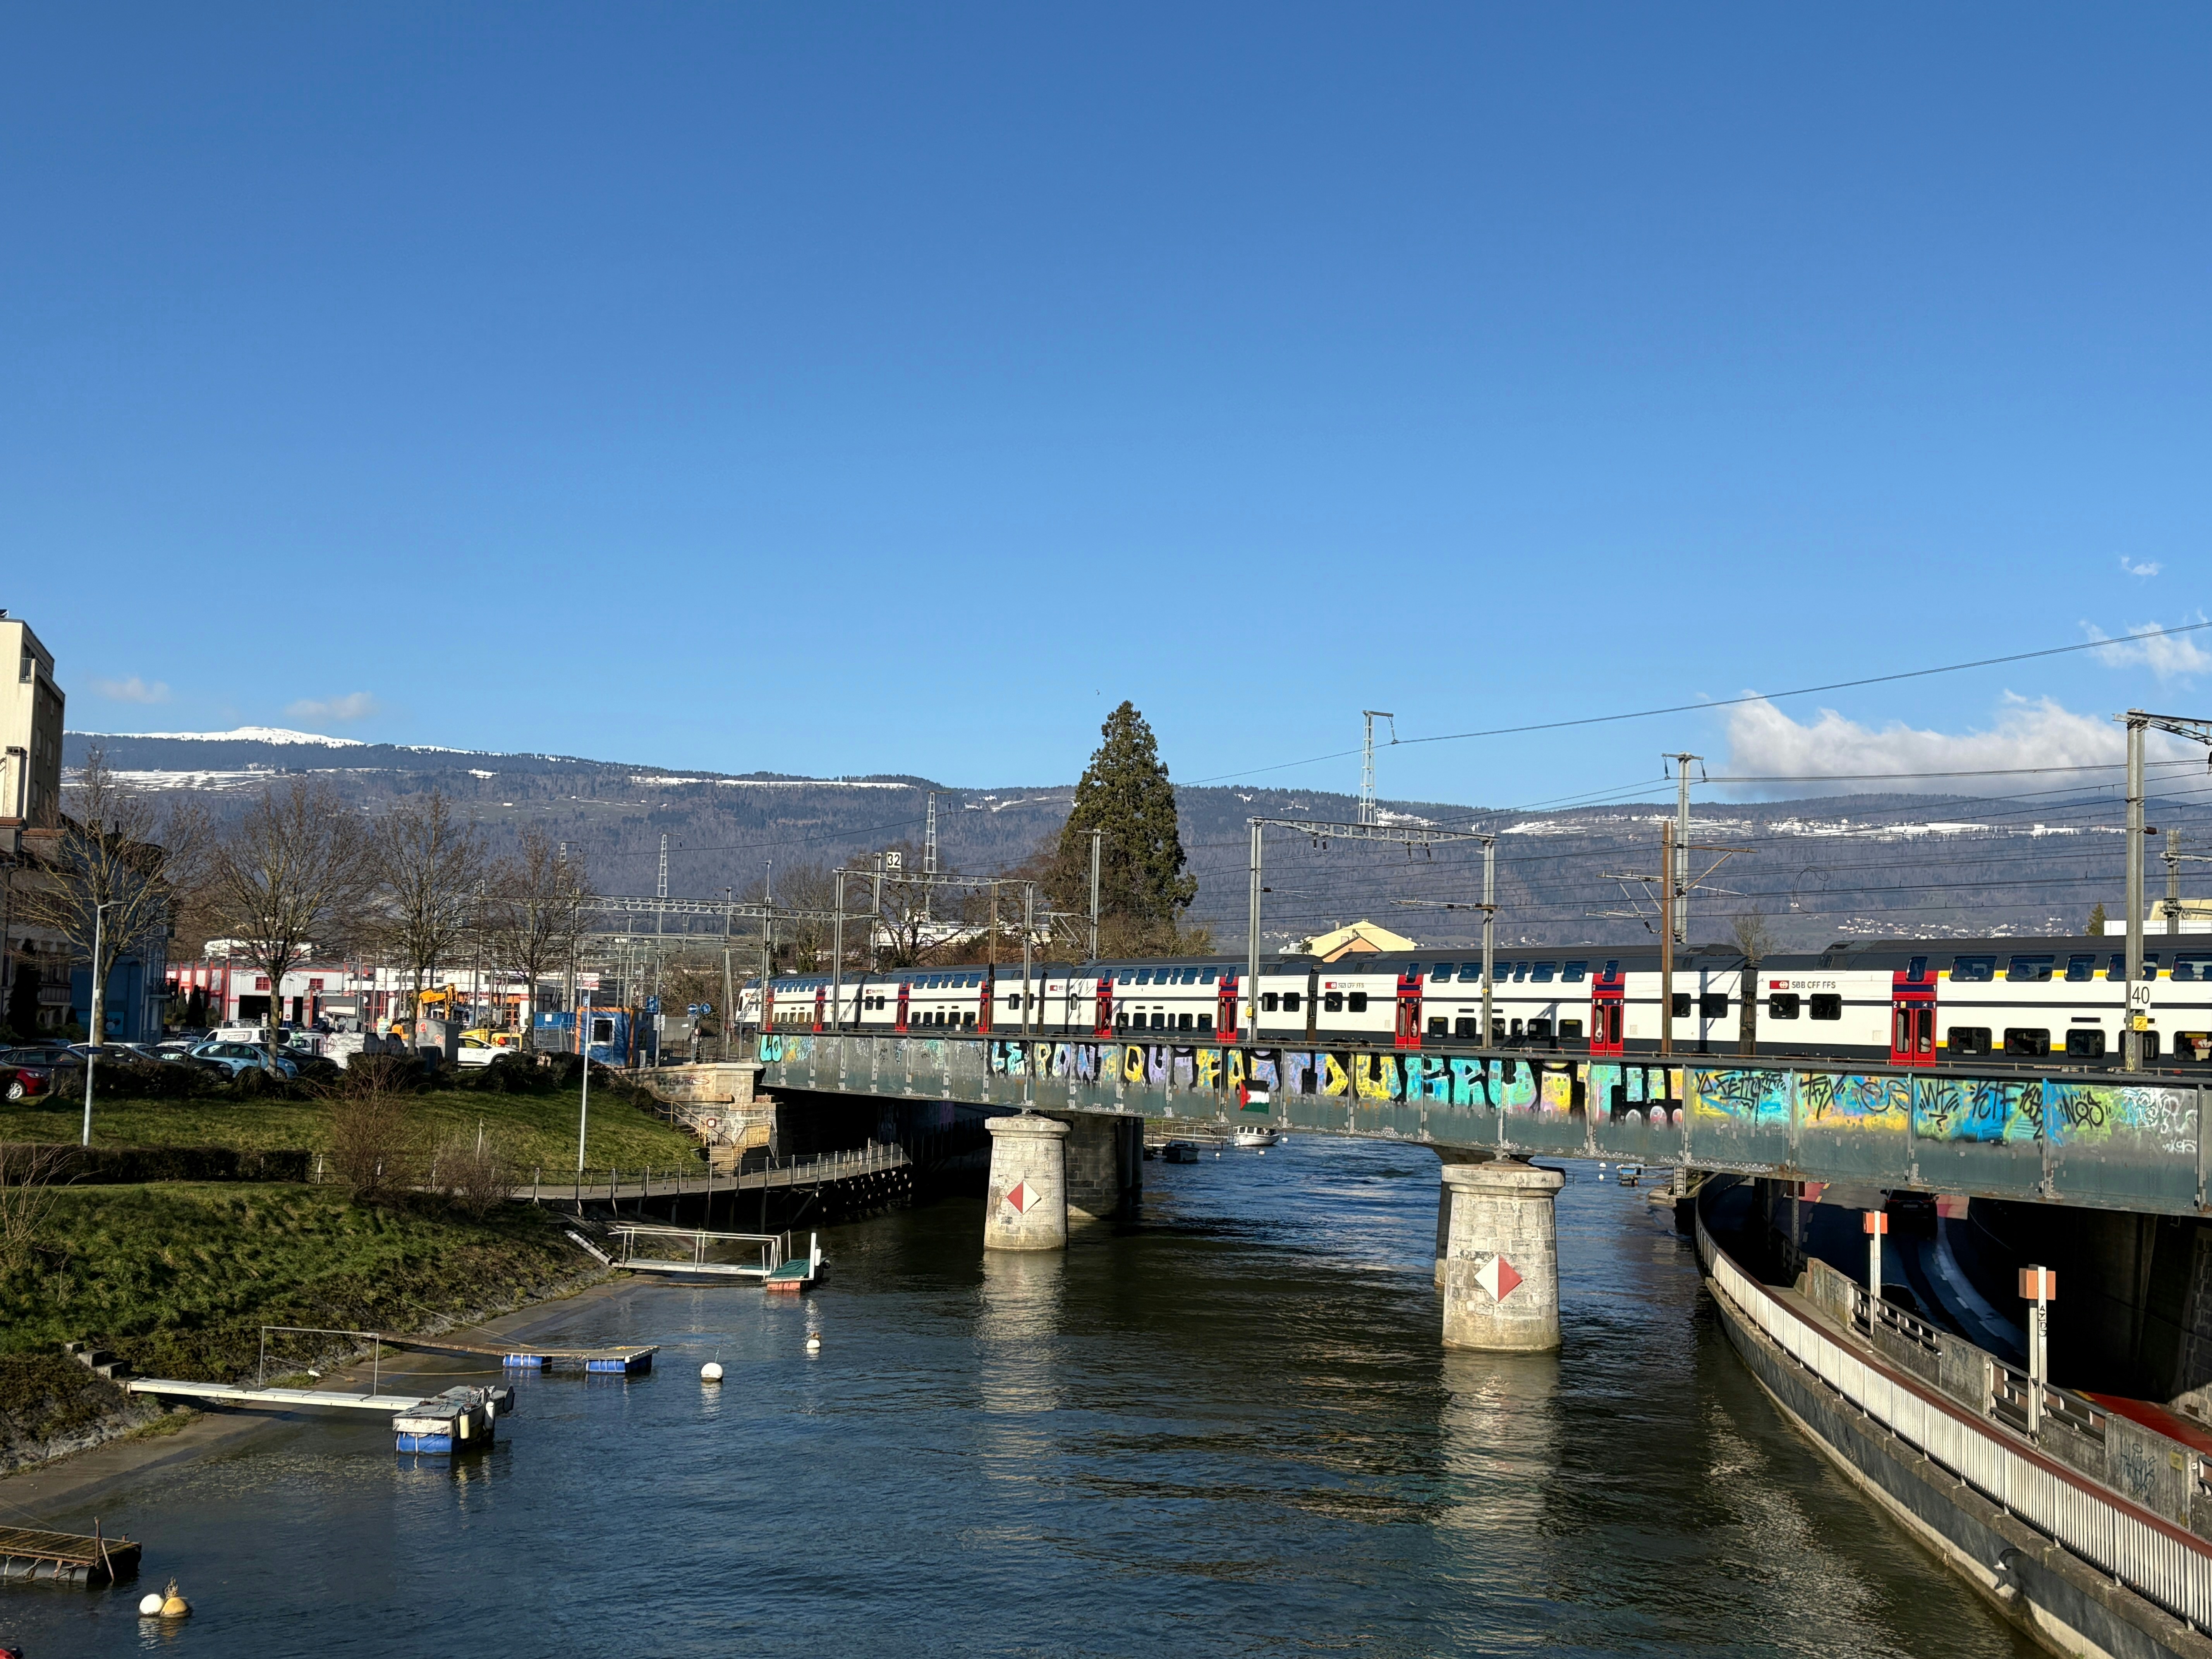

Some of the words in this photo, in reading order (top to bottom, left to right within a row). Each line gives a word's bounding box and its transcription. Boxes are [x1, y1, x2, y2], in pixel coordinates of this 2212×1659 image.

[888, 854, 900, 866] 32
[2132, 986, 2150, 1004] 40
[991, 1042, 1025, 1075] LE
[1034, 1042, 1118, 1082] PONT
[1315, 1053, 1401, 1100] DU
